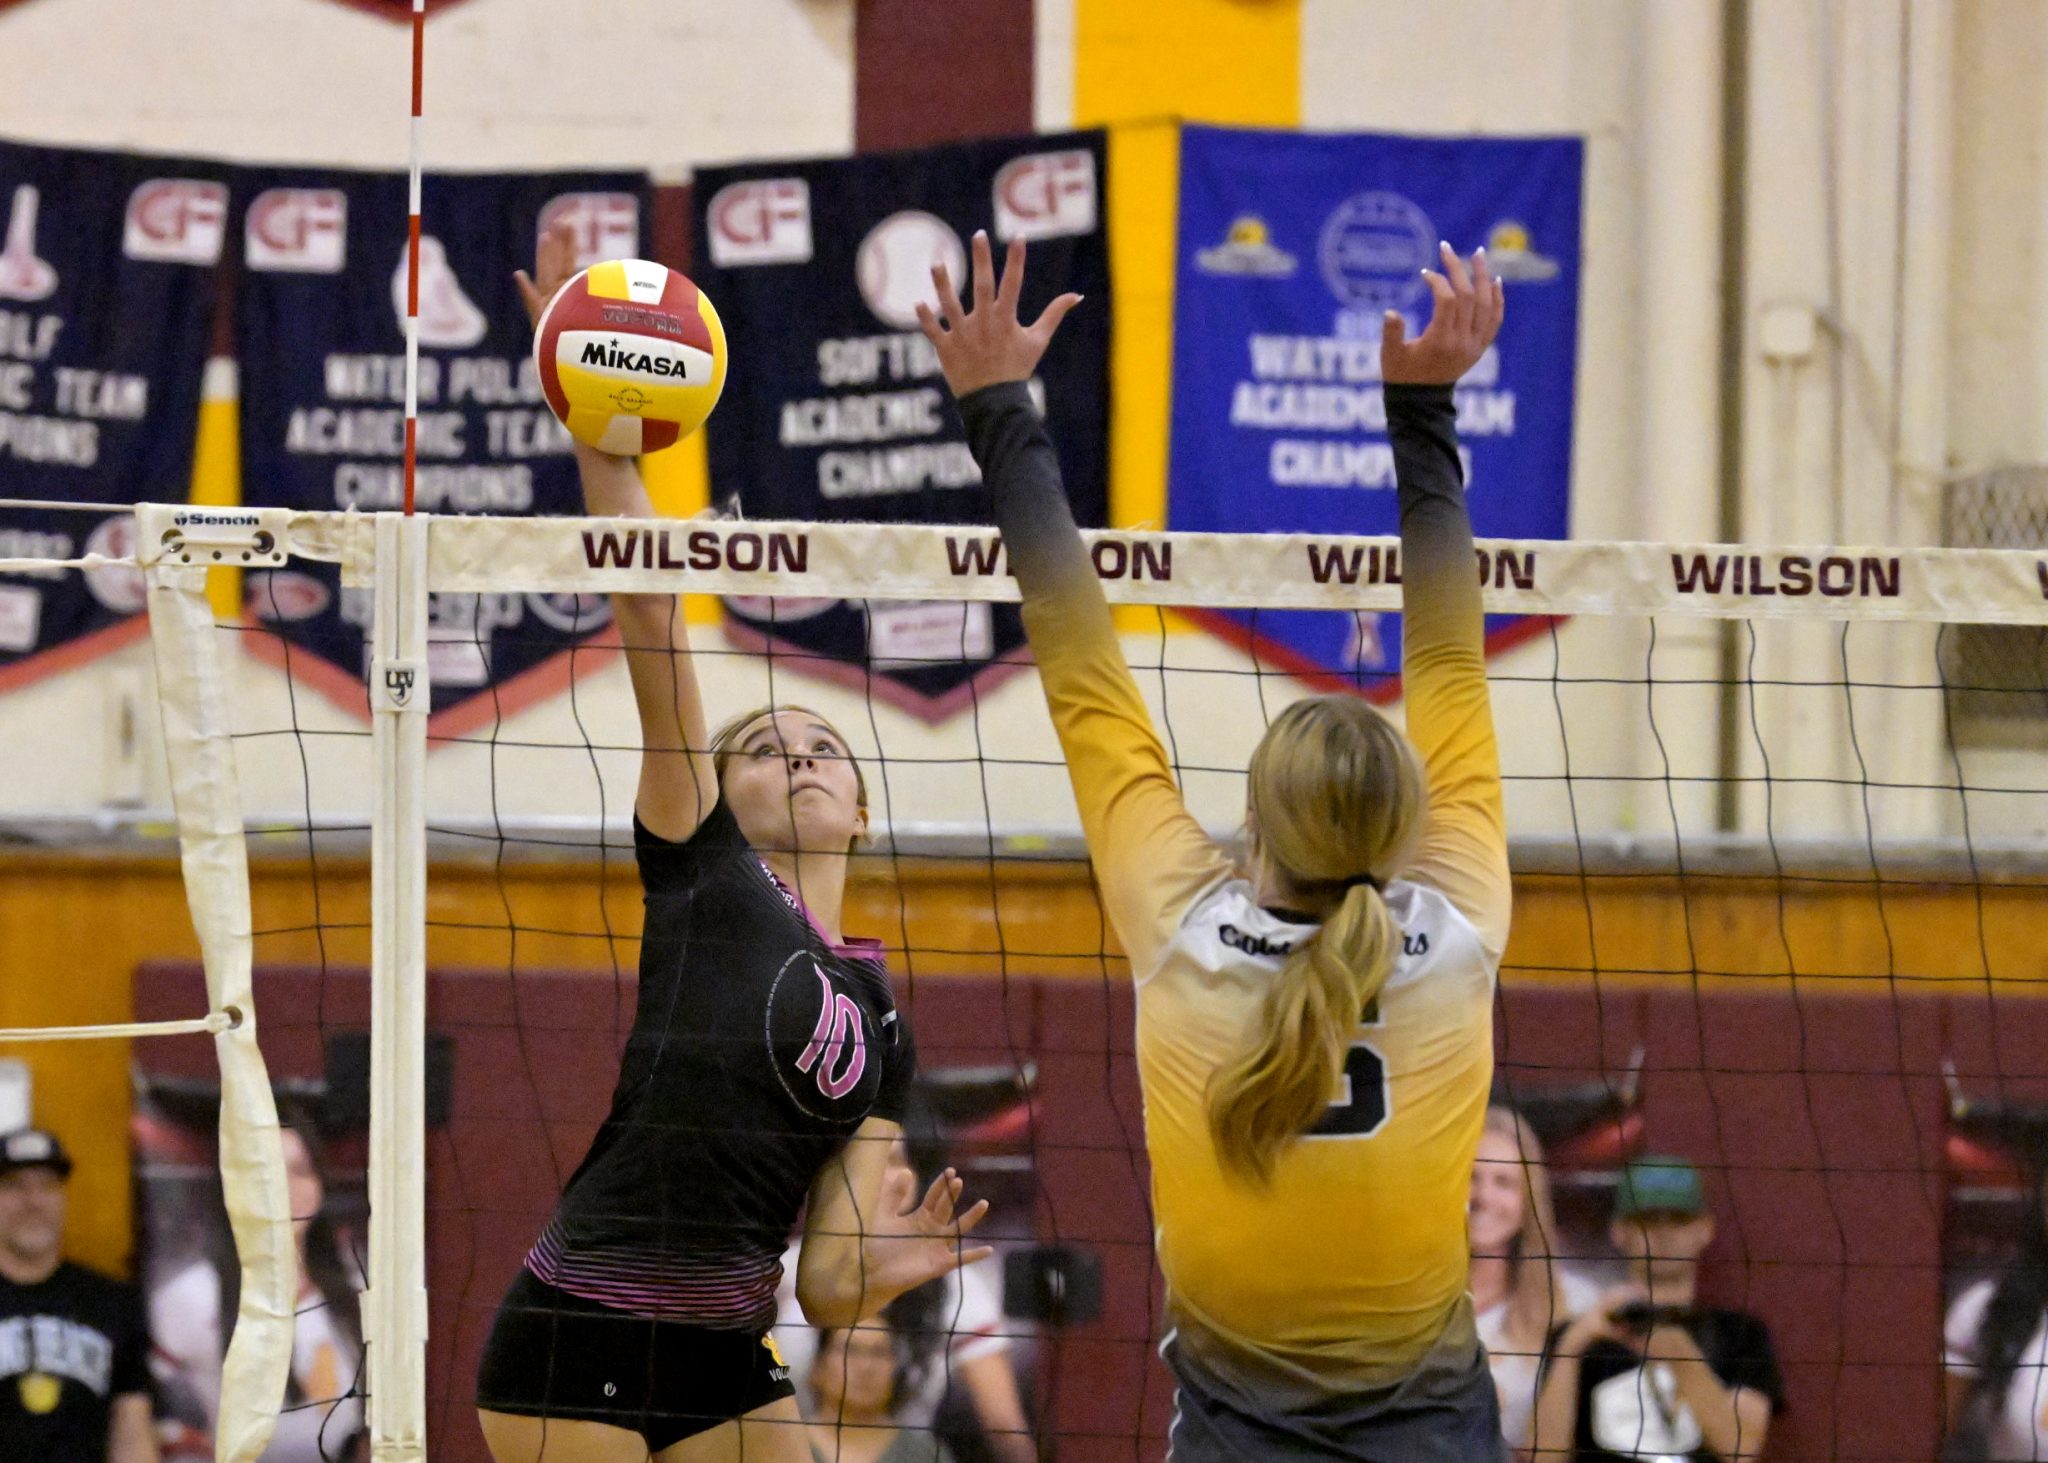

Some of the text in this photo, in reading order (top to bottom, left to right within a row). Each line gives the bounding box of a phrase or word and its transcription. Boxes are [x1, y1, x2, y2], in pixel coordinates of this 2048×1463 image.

[324, 353, 440, 402] WATER
[580, 338, 687, 379] MIKASA
[816, 332, 945, 387] SOFTB
[54, 367, 147, 420] TEAM
[779, 387, 944, 448] ACADEMIC
[286, 406, 466, 459] ACADEMIC
[333, 463, 533, 511] CHAMPIONS
[816, 440, 984, 500] CHAMPIO
[582, 530, 809, 574] WILSON
[945, 537, 1172, 580] WON
[1307, 543, 1536, 590] WILN
[1671, 553, 1900, 598] WILSON
[795, 961, 866, 1100] 10
